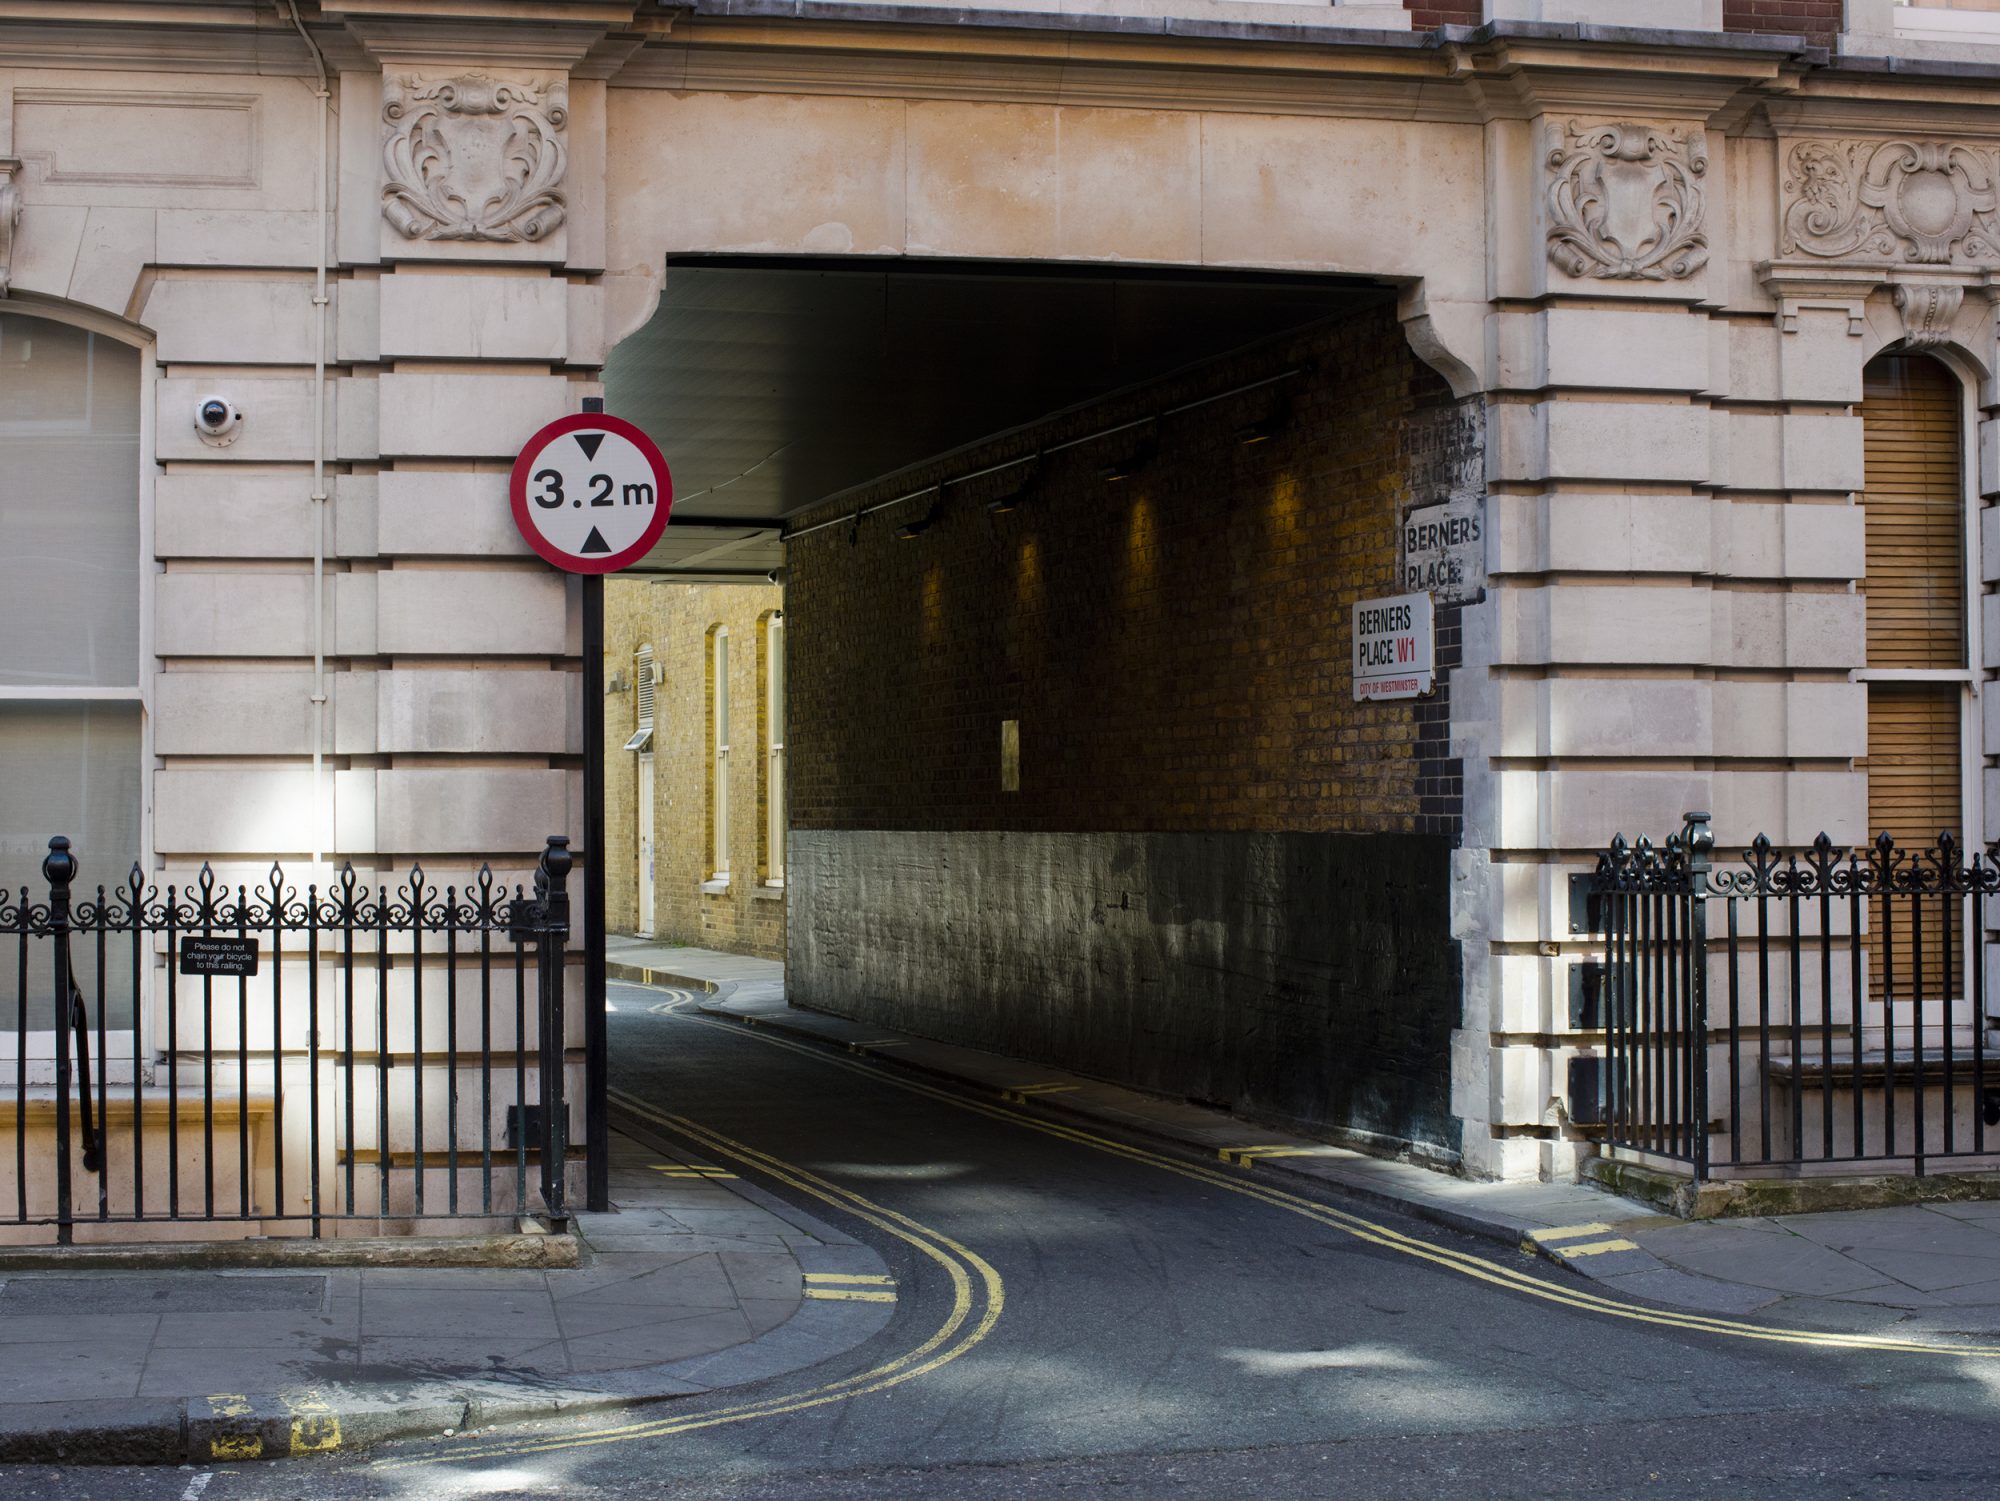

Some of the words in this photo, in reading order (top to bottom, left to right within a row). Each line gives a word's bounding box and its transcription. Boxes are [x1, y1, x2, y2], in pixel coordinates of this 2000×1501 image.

[1407, 517, 1481, 553] BERNERS
[1408, 560, 1457, 590] PLACE
[1359, 604, 1411, 635] BERNERS
[1359, 639, 1394, 667] PLACE
[1397, 637, 1415, 663] W1
[1360, 682, 1372, 695] CITY
[1373, 682, 1379, 694] OF
[1380, 679, 1418, 693] WESTMINSTER
[187, 952, 207, 960] chain
[208, 953, 225, 961] your
[226, 952, 253, 962] bicycle
[194, 942, 220, 951] Please
[221, 943, 231, 951] do
[221, 962, 245, 972] railing.
